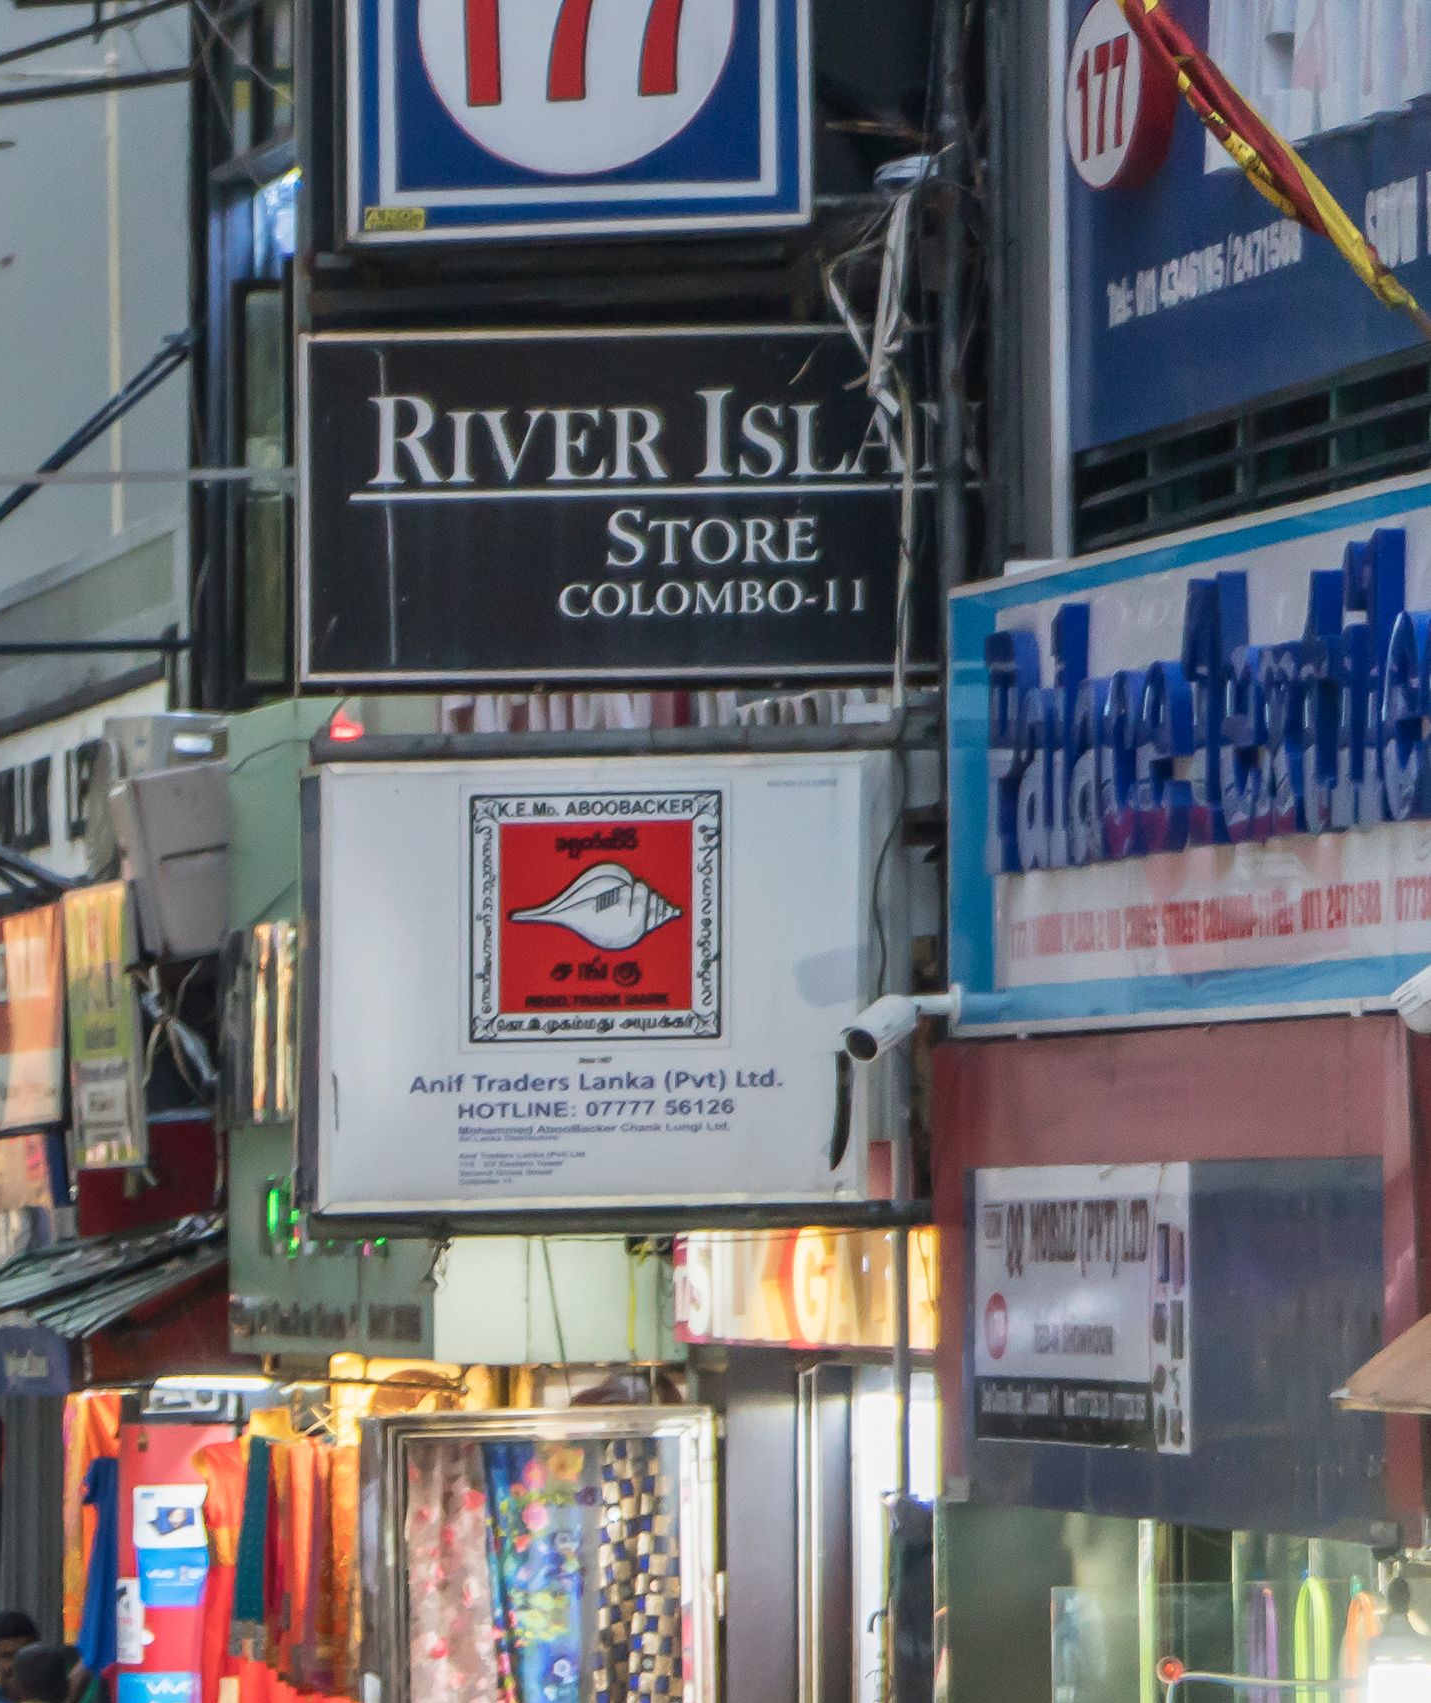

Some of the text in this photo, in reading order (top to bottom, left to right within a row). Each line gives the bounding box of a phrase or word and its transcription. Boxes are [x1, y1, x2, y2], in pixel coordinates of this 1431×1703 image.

[1076, 34, 1130, 161] 177
[558, 578, 865, 620] COLOMBO-11
[565, 799, 695, 816] ABOOBACKER
[409, 1068, 785, 1095] Anif Traders Lanka (Pvt) Ltd.
[458, 1098, 735, 1121] HOTLINE: 07777 56126
